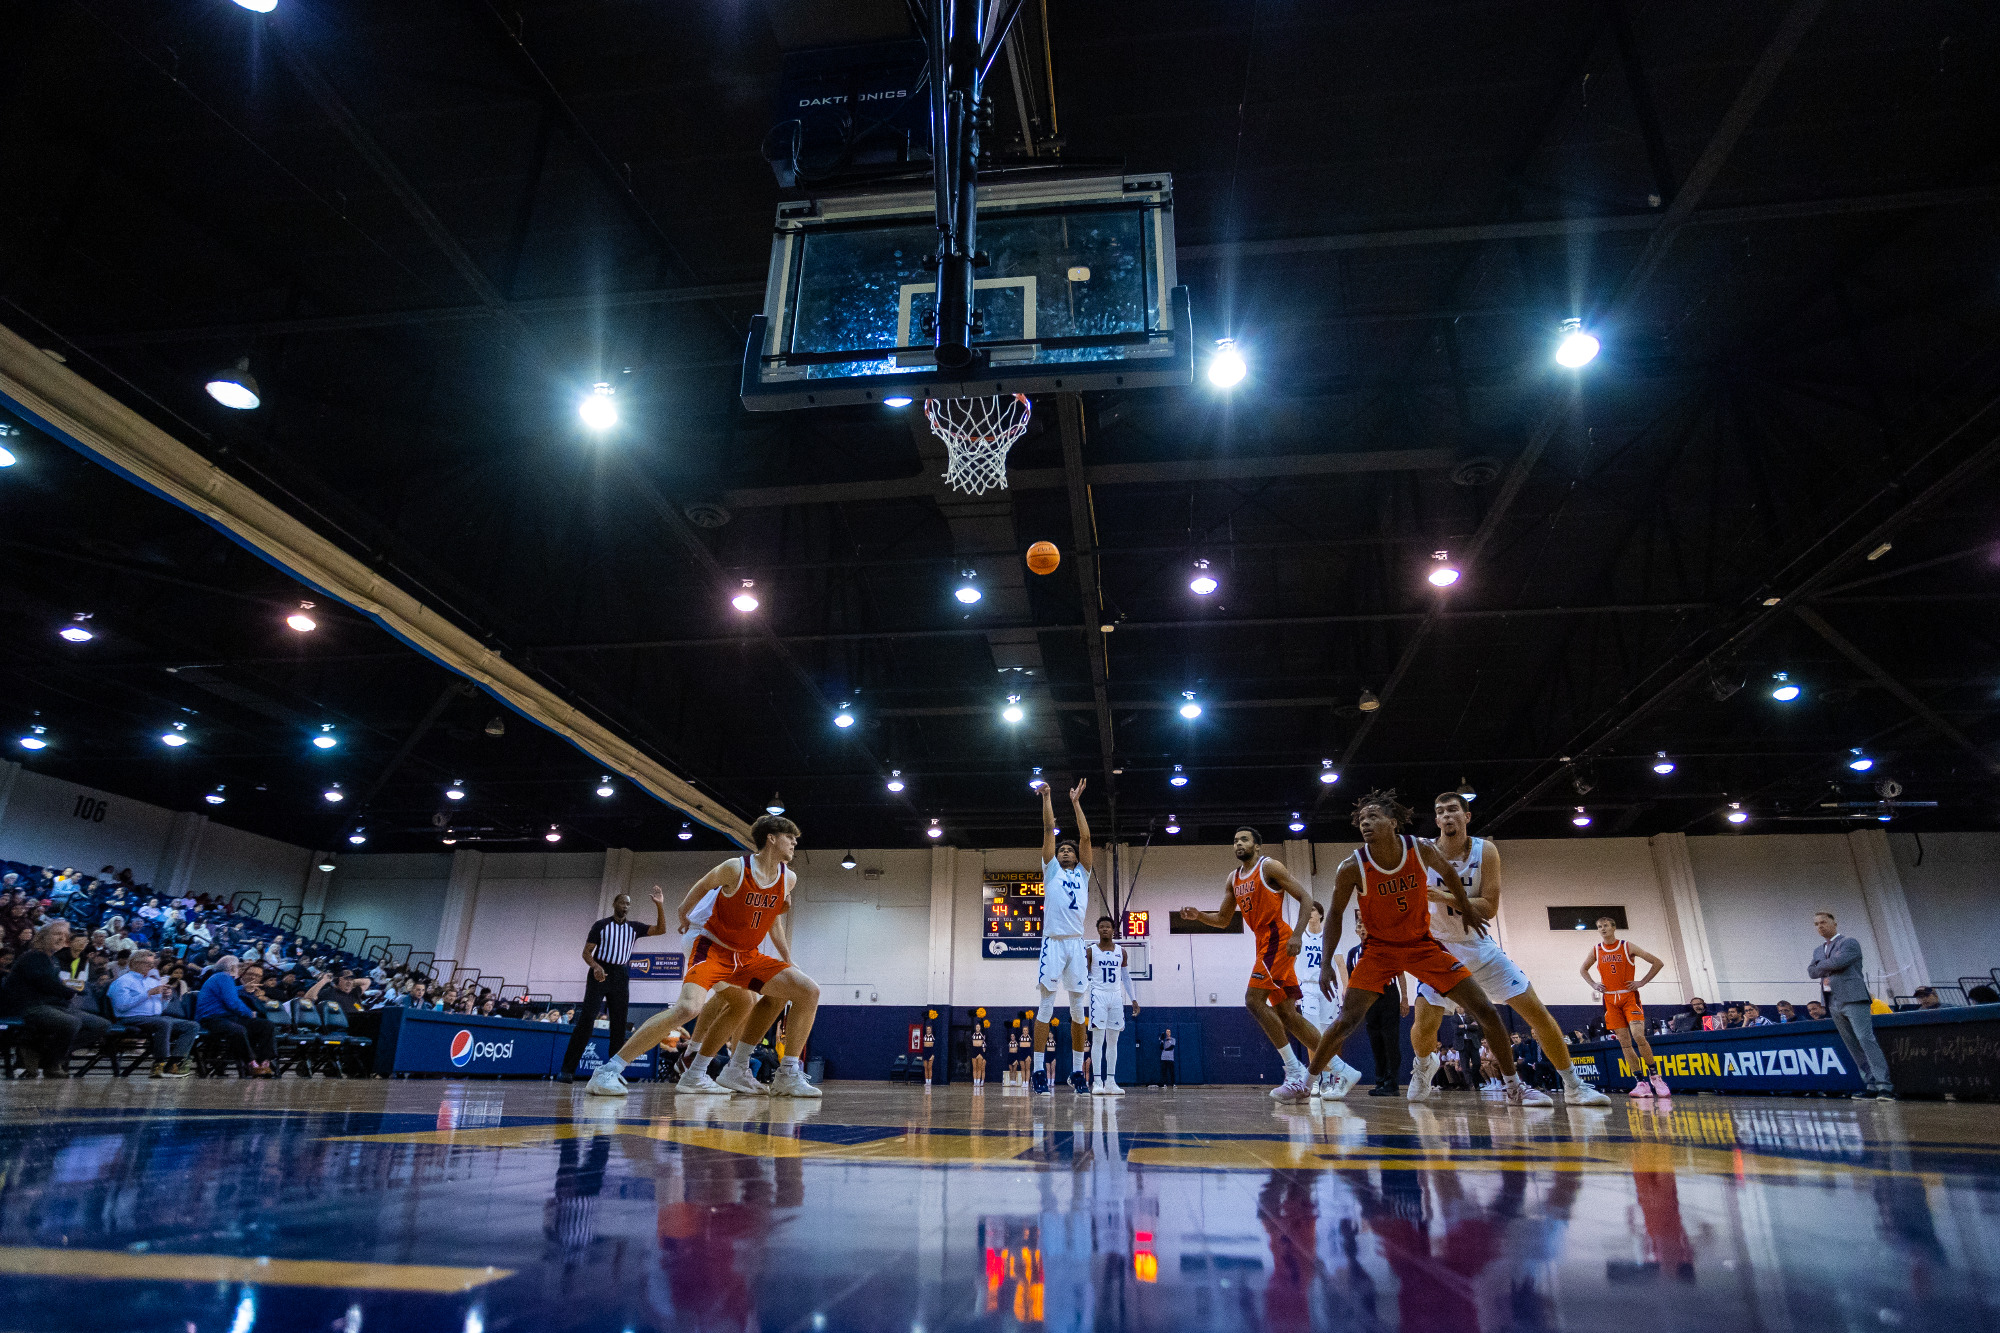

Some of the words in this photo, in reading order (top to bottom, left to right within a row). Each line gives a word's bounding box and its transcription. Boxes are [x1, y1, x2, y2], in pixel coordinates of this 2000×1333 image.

[73, 795, 107, 823] 106
[1062, 880, 1081, 889] NAU
[1377, 874, 1418, 896] OUAZ
[1436, 876, 1473, 887] NU
[745, 892, 778, 909] OUAZ
[1068, 890, 1079, 910] 2
[1241, 897, 1253, 913] 23
[1396, 896, 1408, 912] 5
[992, 905, 1008, 916] 44
[1129, 911, 1148, 921] 2:48
[750, 911, 762, 929] 11
[991, 921, 999, 932] 5
[1004, 921, 1012, 931] 4
[1128, 920, 1145, 935] 30
[1101, 967, 1117, 984] 15
[1610, 964, 1617, 974] 3
[472, 1039, 515, 1062] pepsi
[1571, 1056, 1595, 1065] RTHERN
[1617, 1053, 1722, 1077] NRTHERN
[1723, 1047, 1847, 1077] ARIZONA
